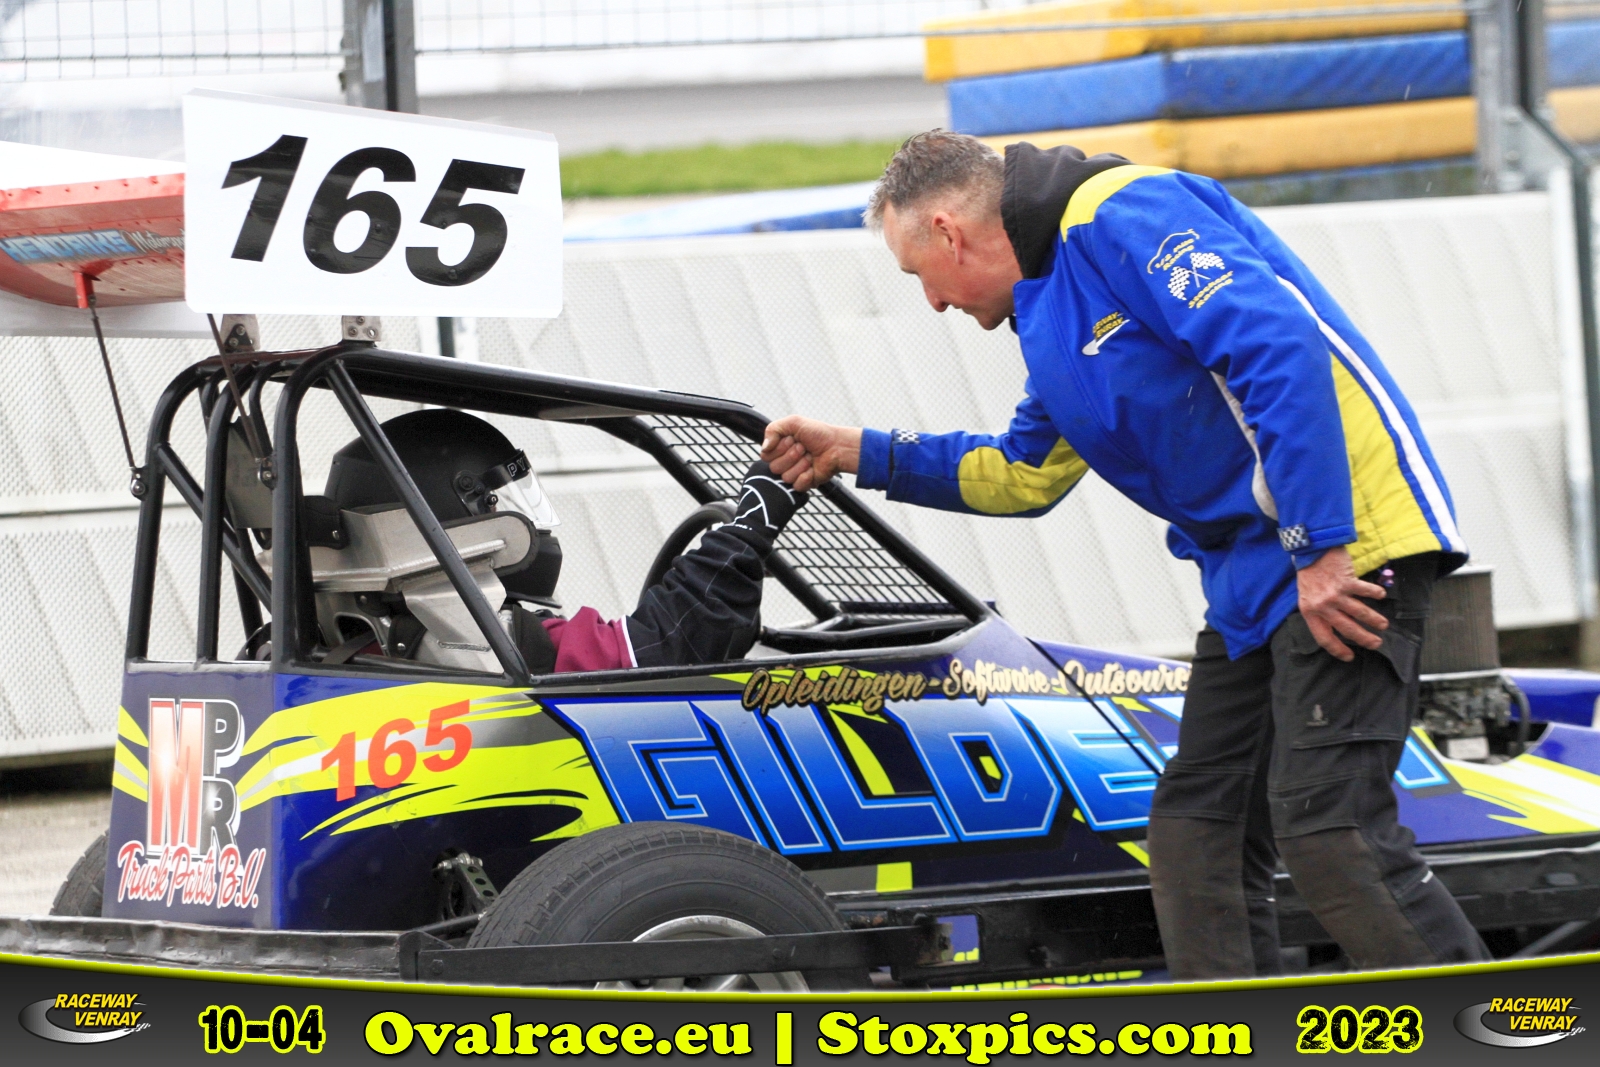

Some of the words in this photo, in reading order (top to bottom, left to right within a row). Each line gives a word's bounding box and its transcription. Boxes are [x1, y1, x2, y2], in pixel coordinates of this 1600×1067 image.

[221, 134, 525, 287] 165
[321, 699, 474, 803] 165
[117, 840, 169, 903] Truck
[166, 842, 217, 907] Parts
[217, 844, 267, 909] B.V.
